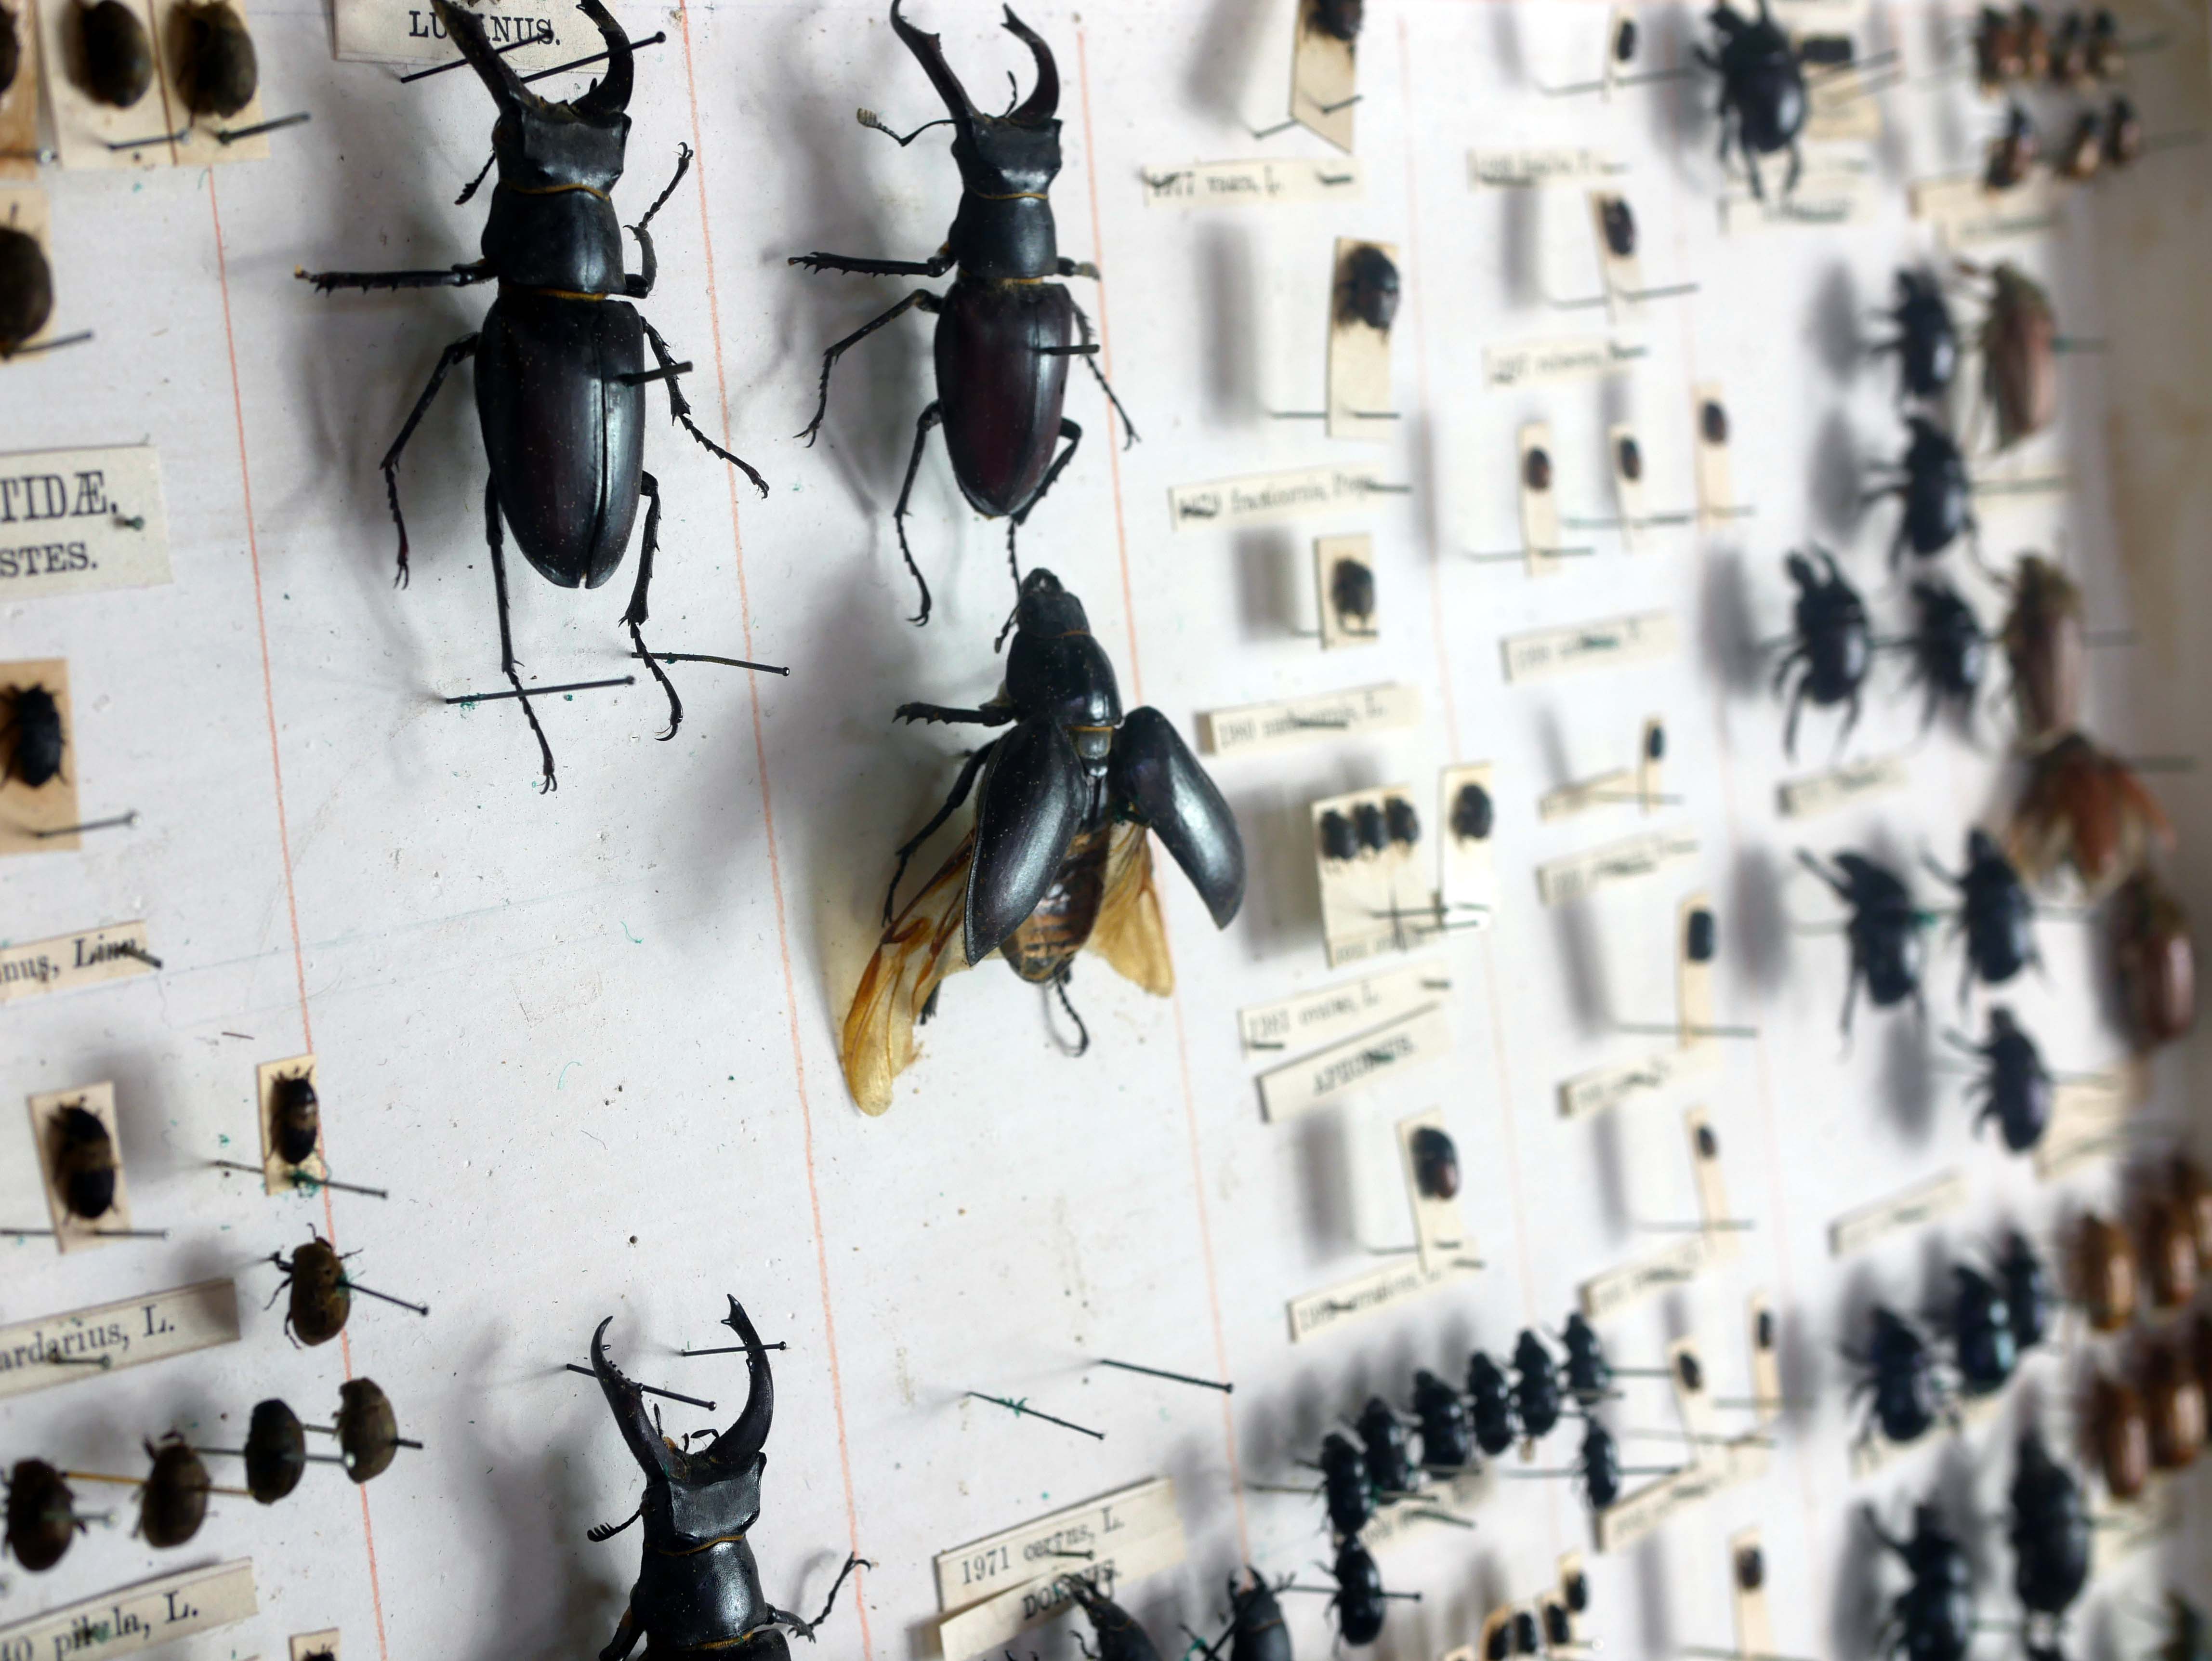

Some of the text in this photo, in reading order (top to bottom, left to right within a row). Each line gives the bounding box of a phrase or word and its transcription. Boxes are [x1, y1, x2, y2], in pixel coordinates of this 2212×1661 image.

[408, 10, 561, 46] LUNUS.
[141, 1304, 175, 1337] L.
[961, 1546, 1010, 1584] 1971
[53, 1606, 151, 1661] pilla,
[164, 1590, 198, 1624] L.
